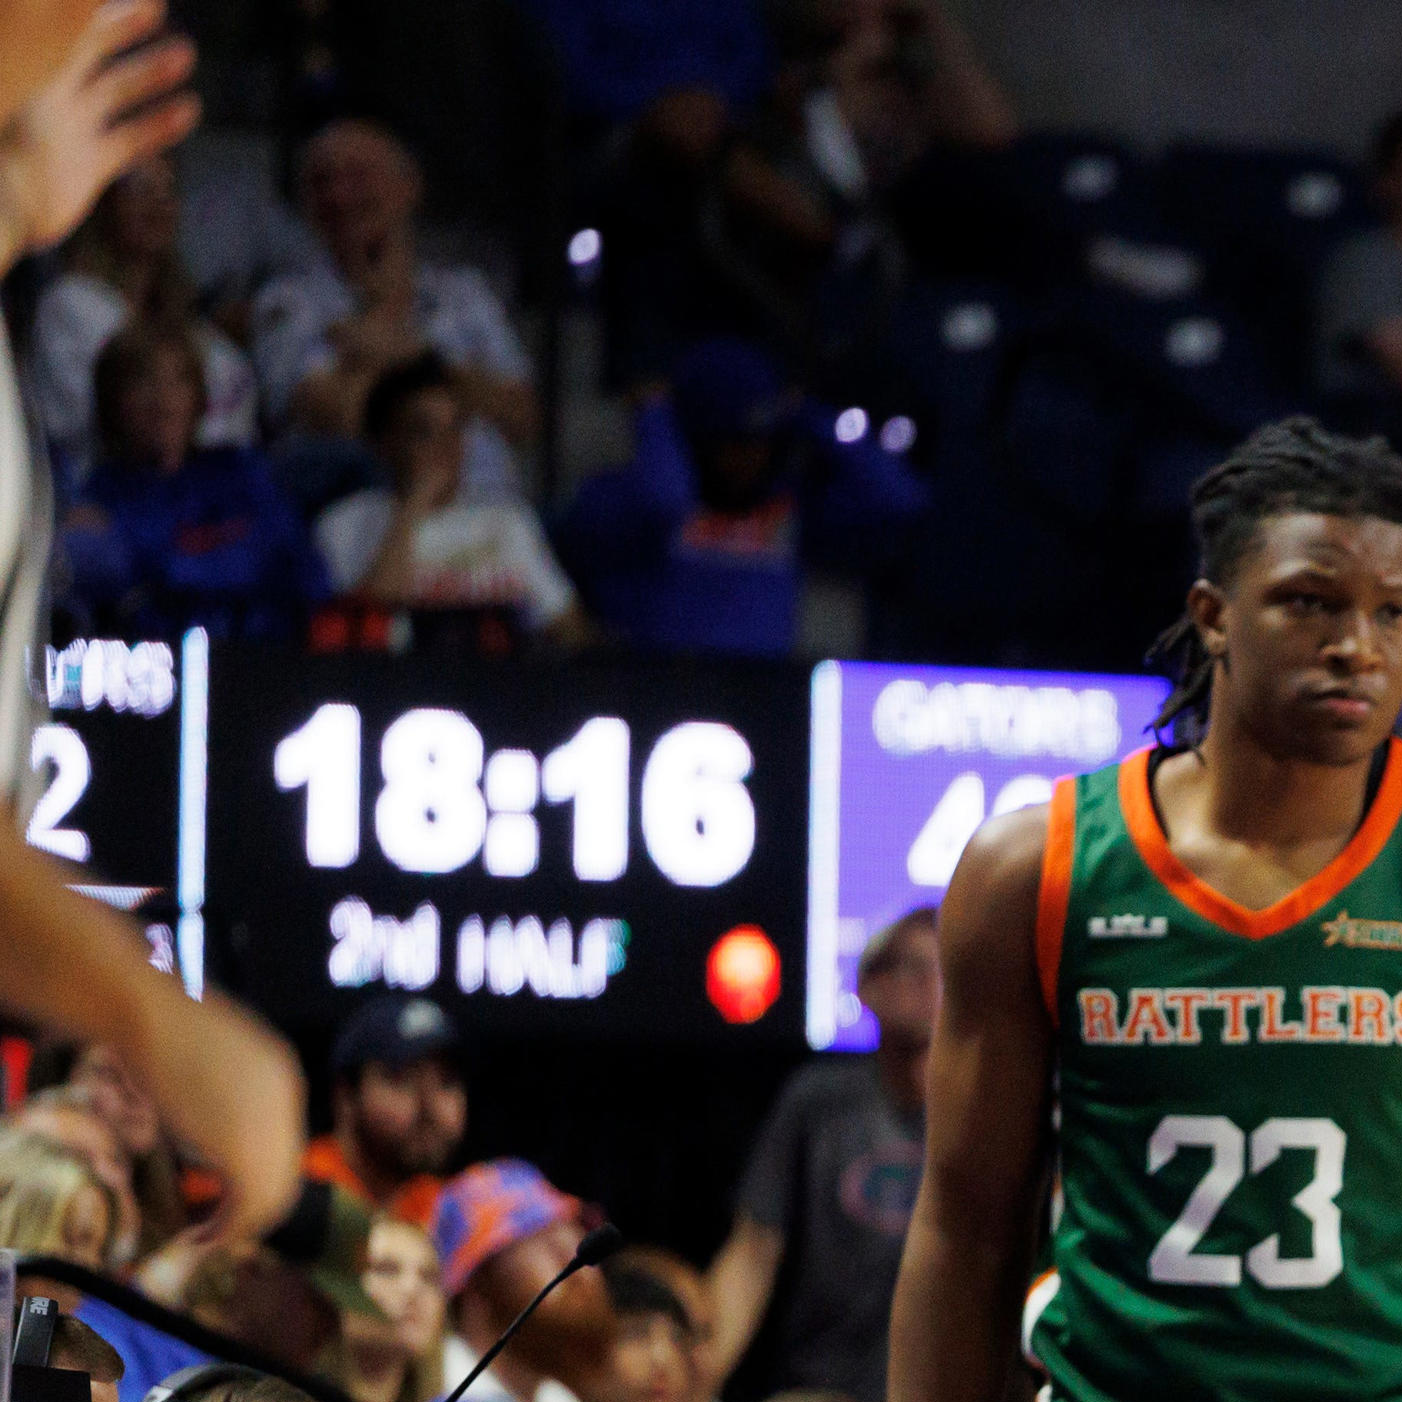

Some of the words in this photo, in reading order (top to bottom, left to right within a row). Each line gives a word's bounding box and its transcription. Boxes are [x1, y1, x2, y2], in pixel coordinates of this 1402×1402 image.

[274, 702, 756, 888] 18:16
[328, 895, 441, 989] 2nd
[457, 912, 632, 999] HALF
[1146, 1114, 1347, 1289] 23
